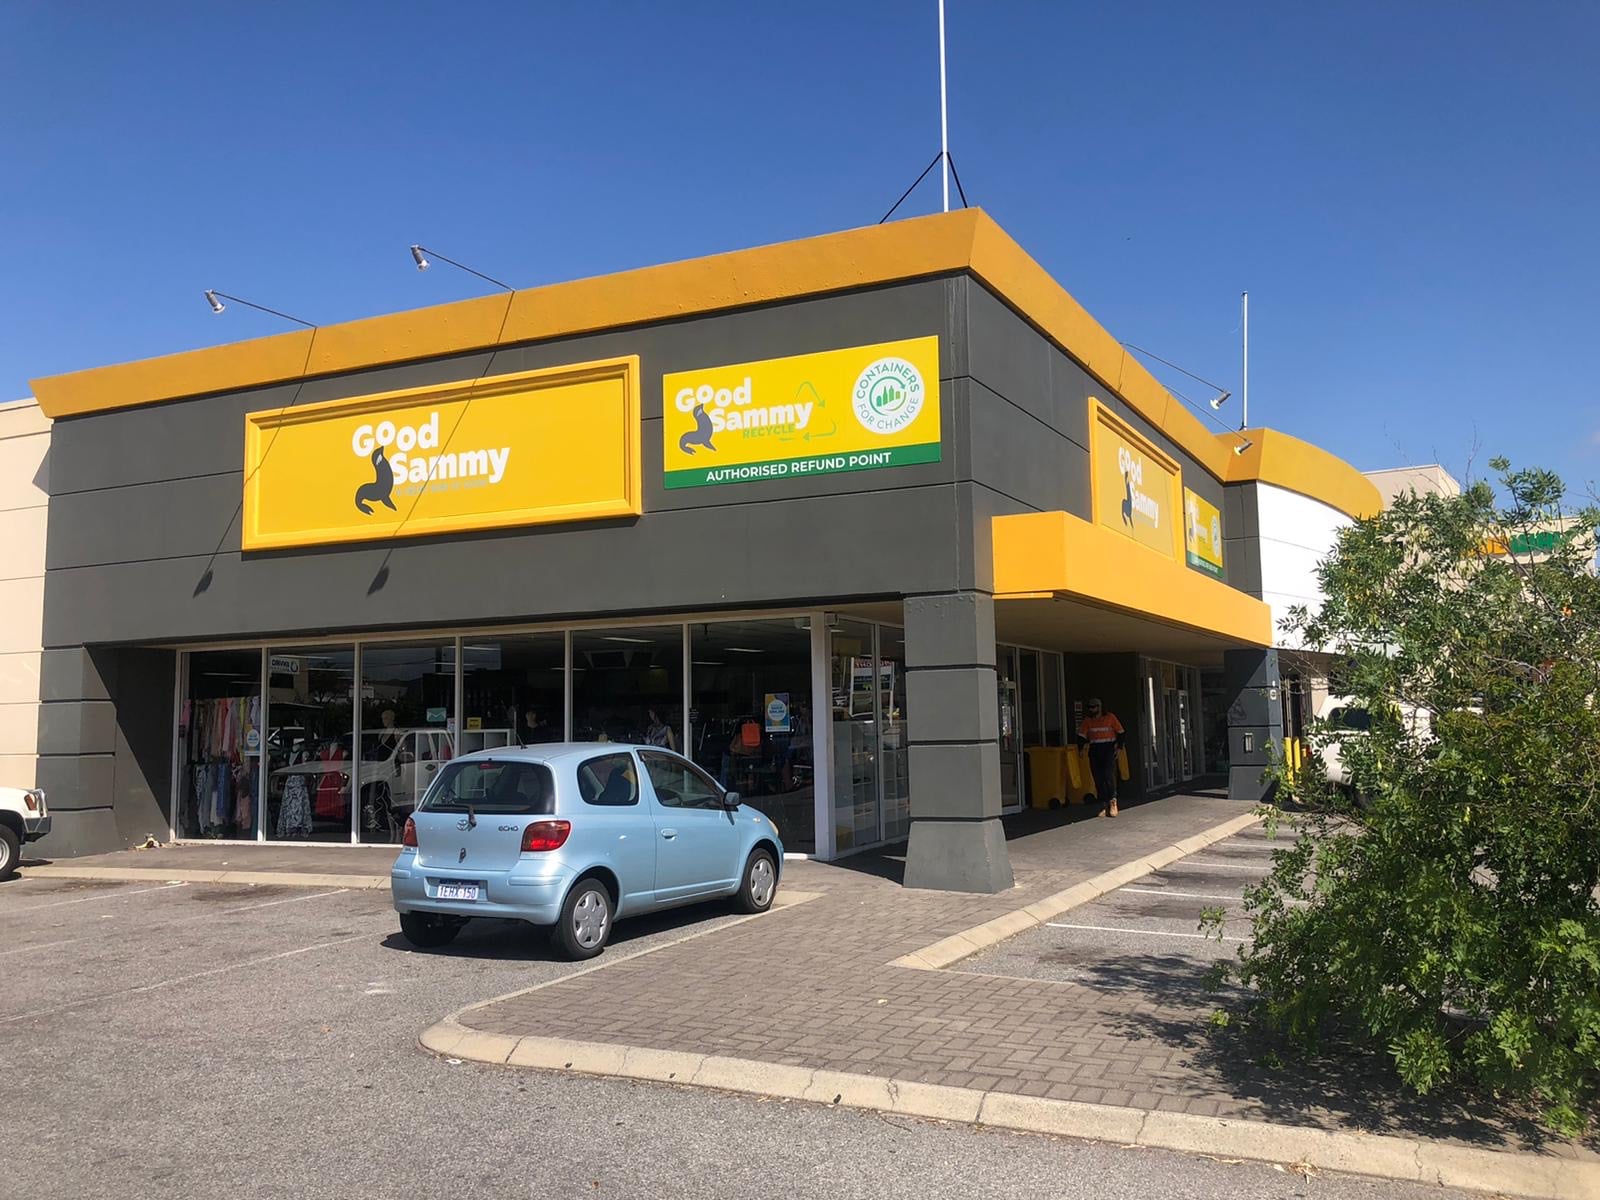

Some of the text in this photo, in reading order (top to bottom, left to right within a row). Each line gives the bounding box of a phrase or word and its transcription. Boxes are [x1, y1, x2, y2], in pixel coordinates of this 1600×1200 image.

[675, 376, 752, 412] Good
[857, 362, 919, 399] CONTAINERS
[709, 401, 814, 433] Sammy
[742, 423, 796, 439] RECYCLE
[858, 398, 919, 430] FOR CHANGE
[352, 411, 439, 457] Good
[389, 447, 510, 485] Sammy
[706, 452, 892, 482] AUTHORISED REFUND POINT
[1118, 446, 1143, 486] Good
[1129, 481, 1158, 529] Sammy
